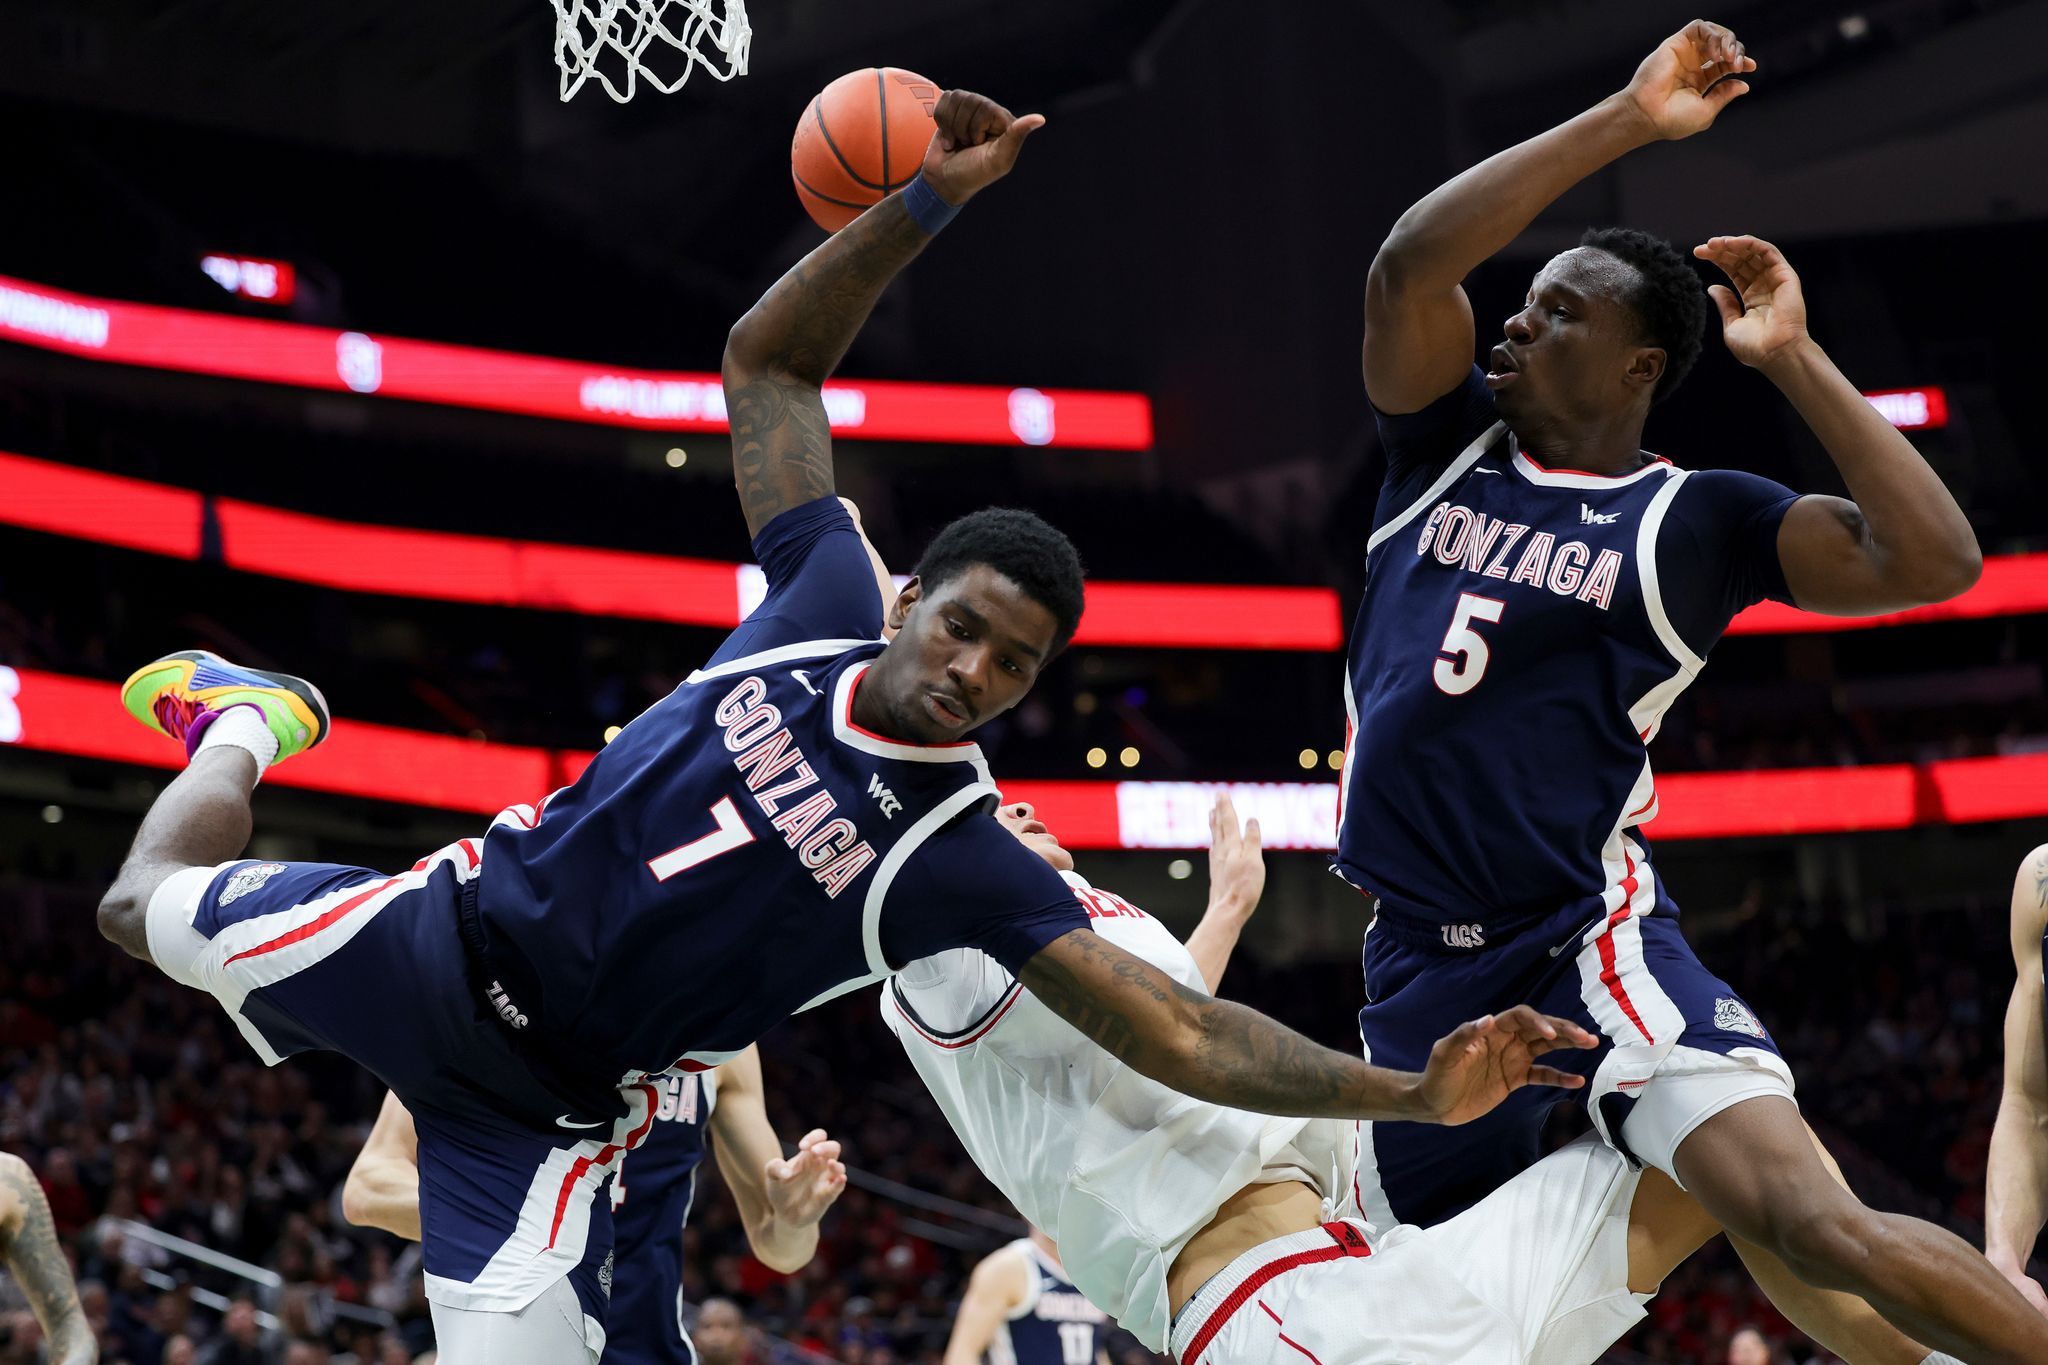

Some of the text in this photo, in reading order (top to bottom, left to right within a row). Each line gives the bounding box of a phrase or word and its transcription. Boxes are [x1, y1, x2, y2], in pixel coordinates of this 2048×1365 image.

[1417, 501, 1623, 611] GONZAGA
[1432, 591, 1507, 696] 5
[714, 675, 877, 900] GONZAGA
[867, 772, 903, 820] WCC
[645, 795, 757, 883] 7
[485, 980, 529, 1029] ZAGS
